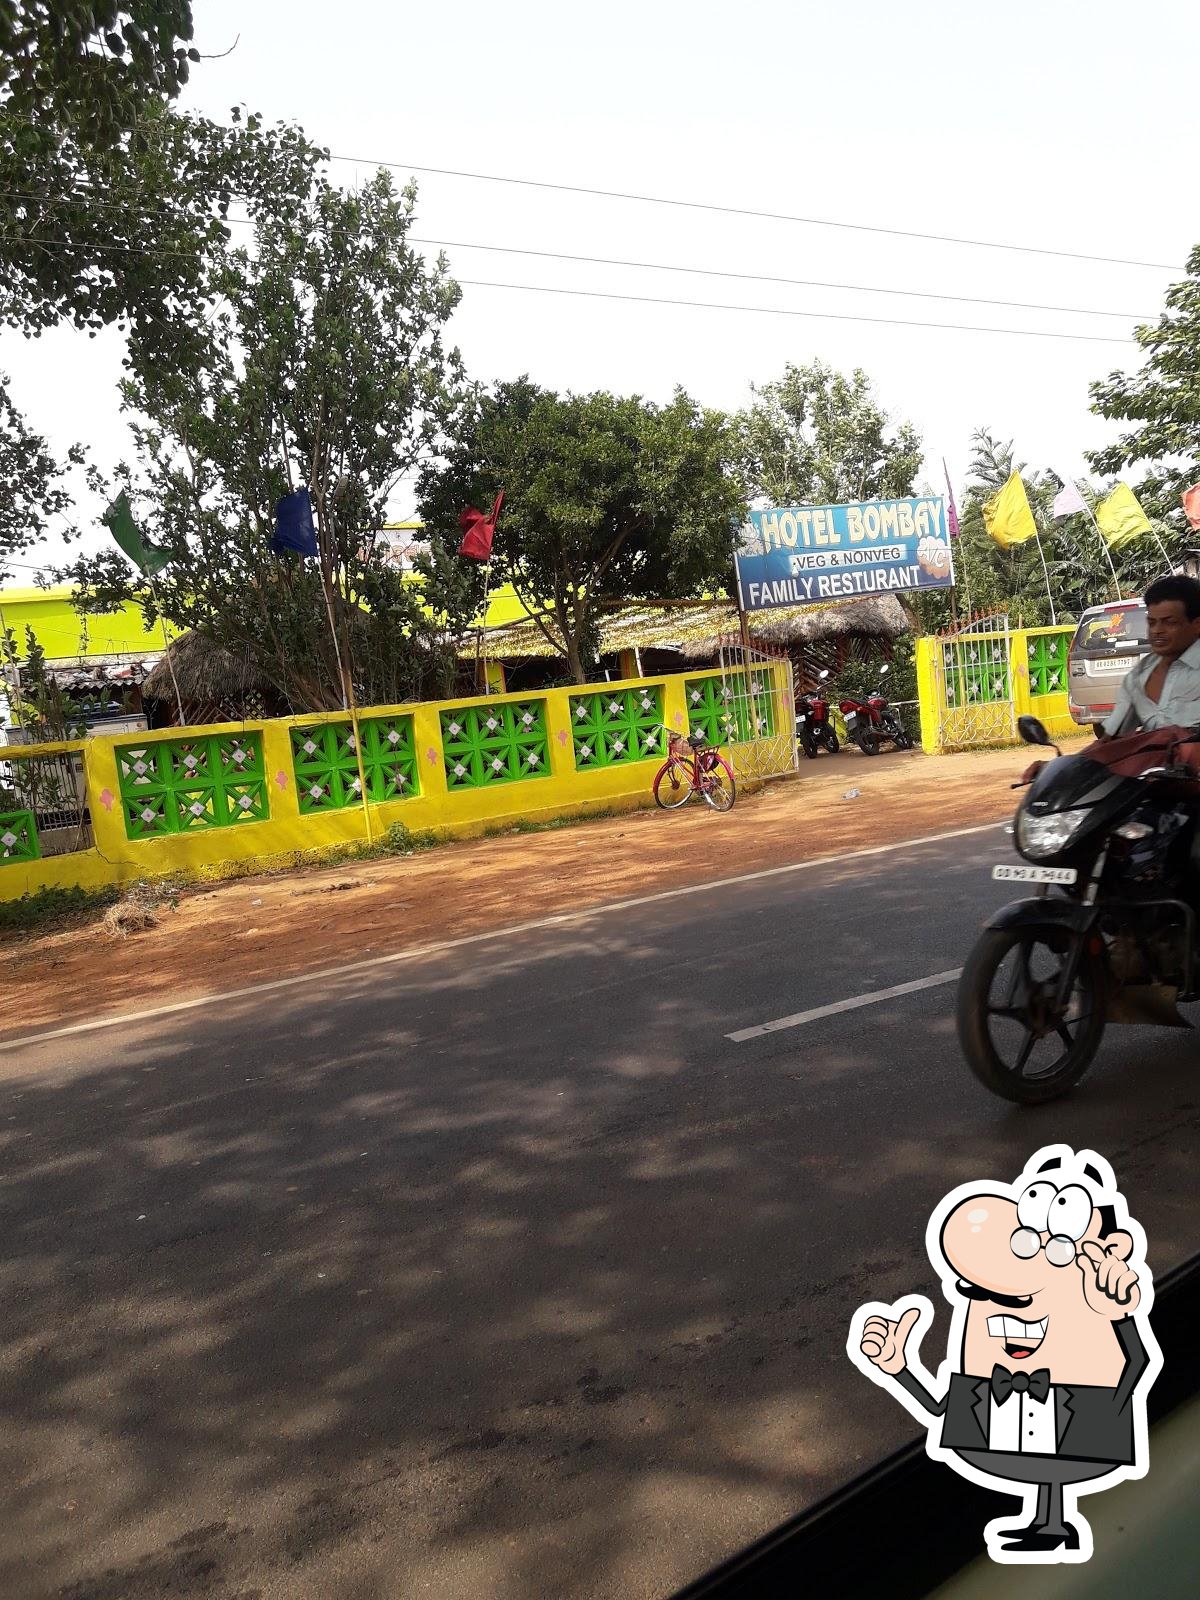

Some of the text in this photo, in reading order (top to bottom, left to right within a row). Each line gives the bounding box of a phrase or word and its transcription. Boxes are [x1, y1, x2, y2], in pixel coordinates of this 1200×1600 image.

[760, 500, 942, 554] HOTEL BOMBAY
[796, 546, 901, 570] VEG & NONVEG
[919, 545, 948, 569] A/C
[749, 565, 921, 606] FAMILY RESTURANT
